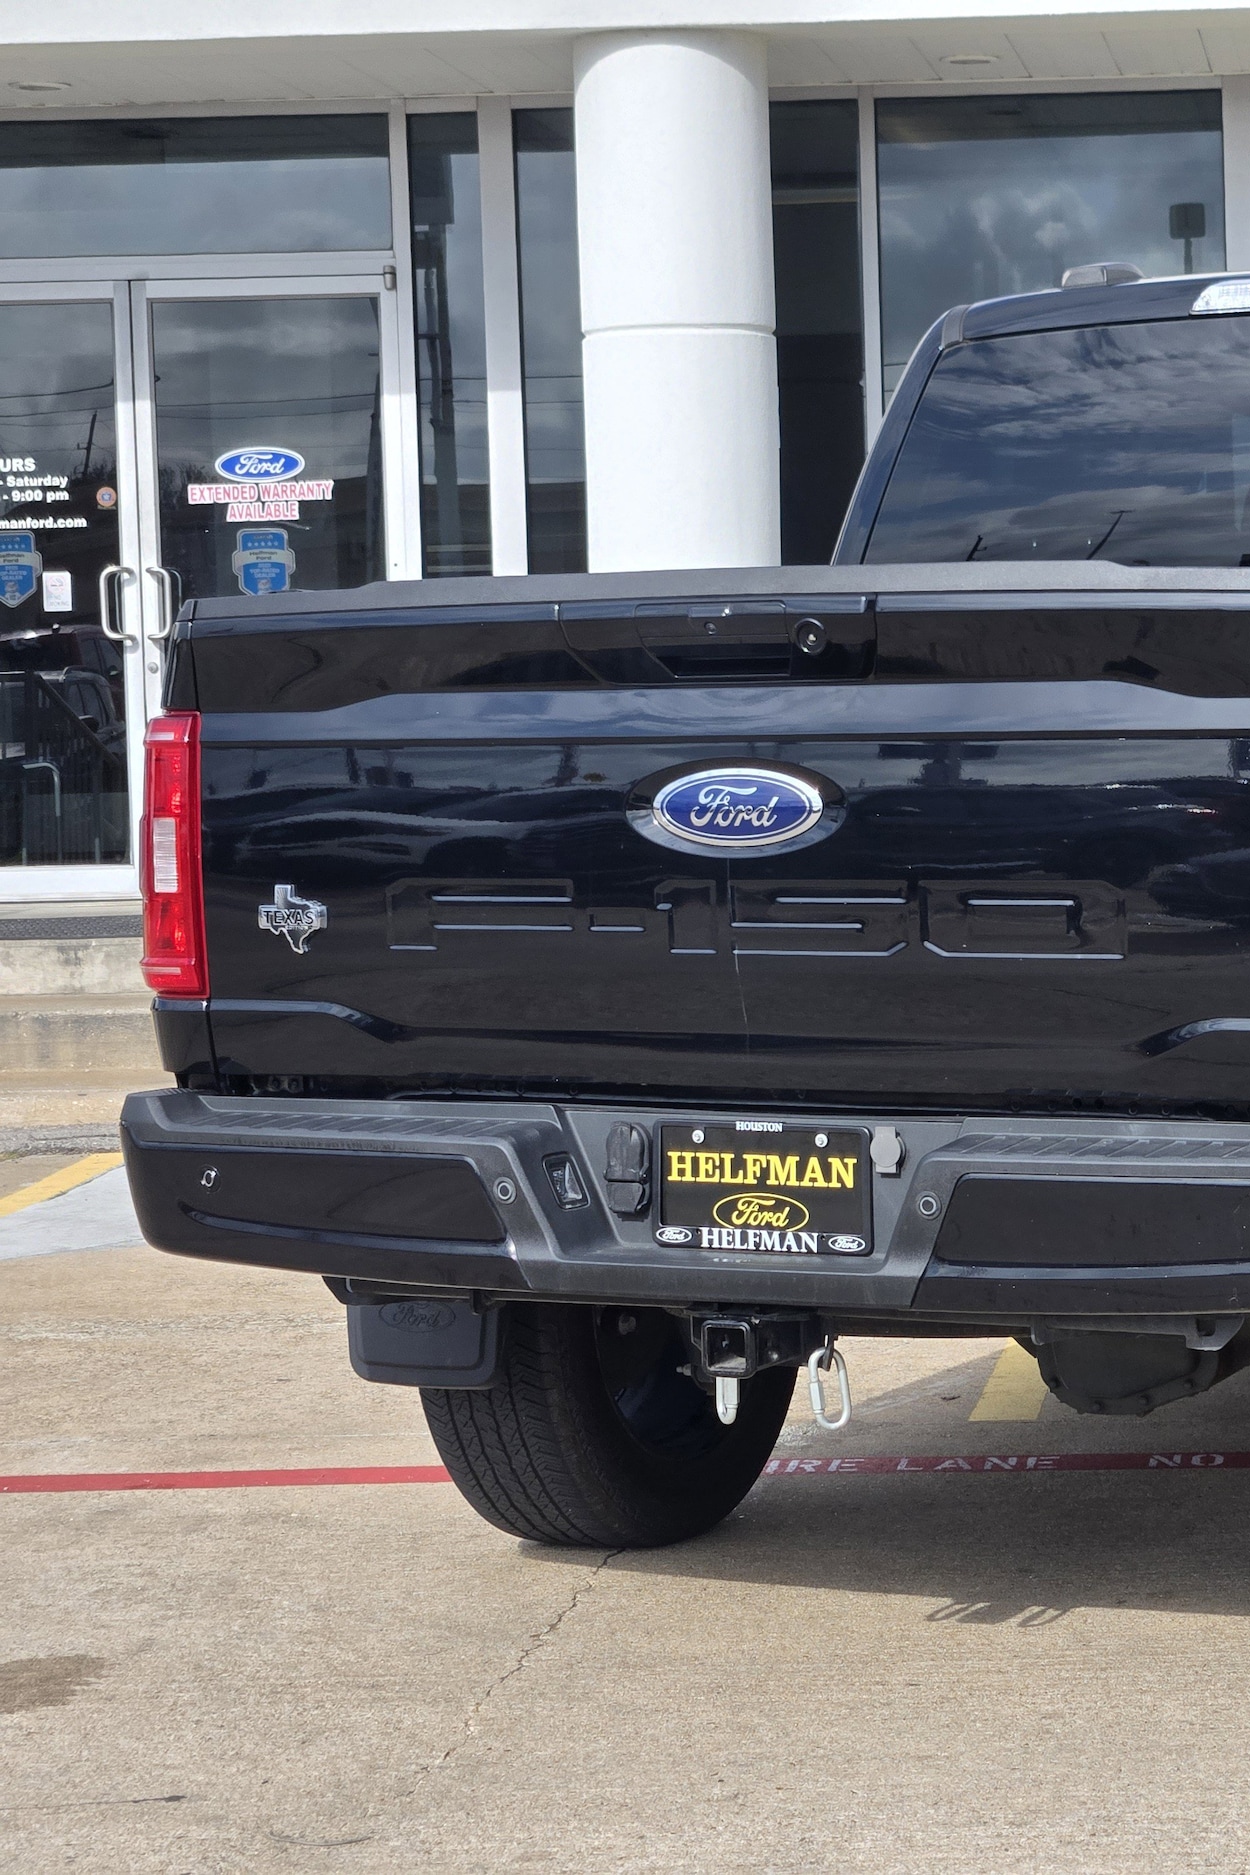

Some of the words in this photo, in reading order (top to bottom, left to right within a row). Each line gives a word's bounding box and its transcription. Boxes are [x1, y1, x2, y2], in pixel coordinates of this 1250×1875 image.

[0, 457, 36, 472] URS
[234, 453, 286, 475] Ford
[6, 474, 69, 488] Saturday
[11, 489, 43, 502] 9:00
[46, 490, 70, 503] pm
[189, 484, 257, 502] EXTENDED
[260, 482, 332, 500] WARRANTY
[228, 502, 298, 520] AVAILABLE
[0, 516, 87, 529] manford.com
[689, 784, 780, 827] Ford
[263, 909, 315, 926] TEXAS
[735, 1121, 783, 1133] HOUSTON
[667, 1151, 858, 1189] HELFMAN
[731, 1197, 791, 1228] Ford
[700, 1227, 818, 1254] HELFMAN
[392, 1301, 442, 1328] Ford
[765, 1458, 865, 1474] IRE
[896, 1456, 1061, 1472] LANE
[1147, 1453, 1225, 1467] NO
